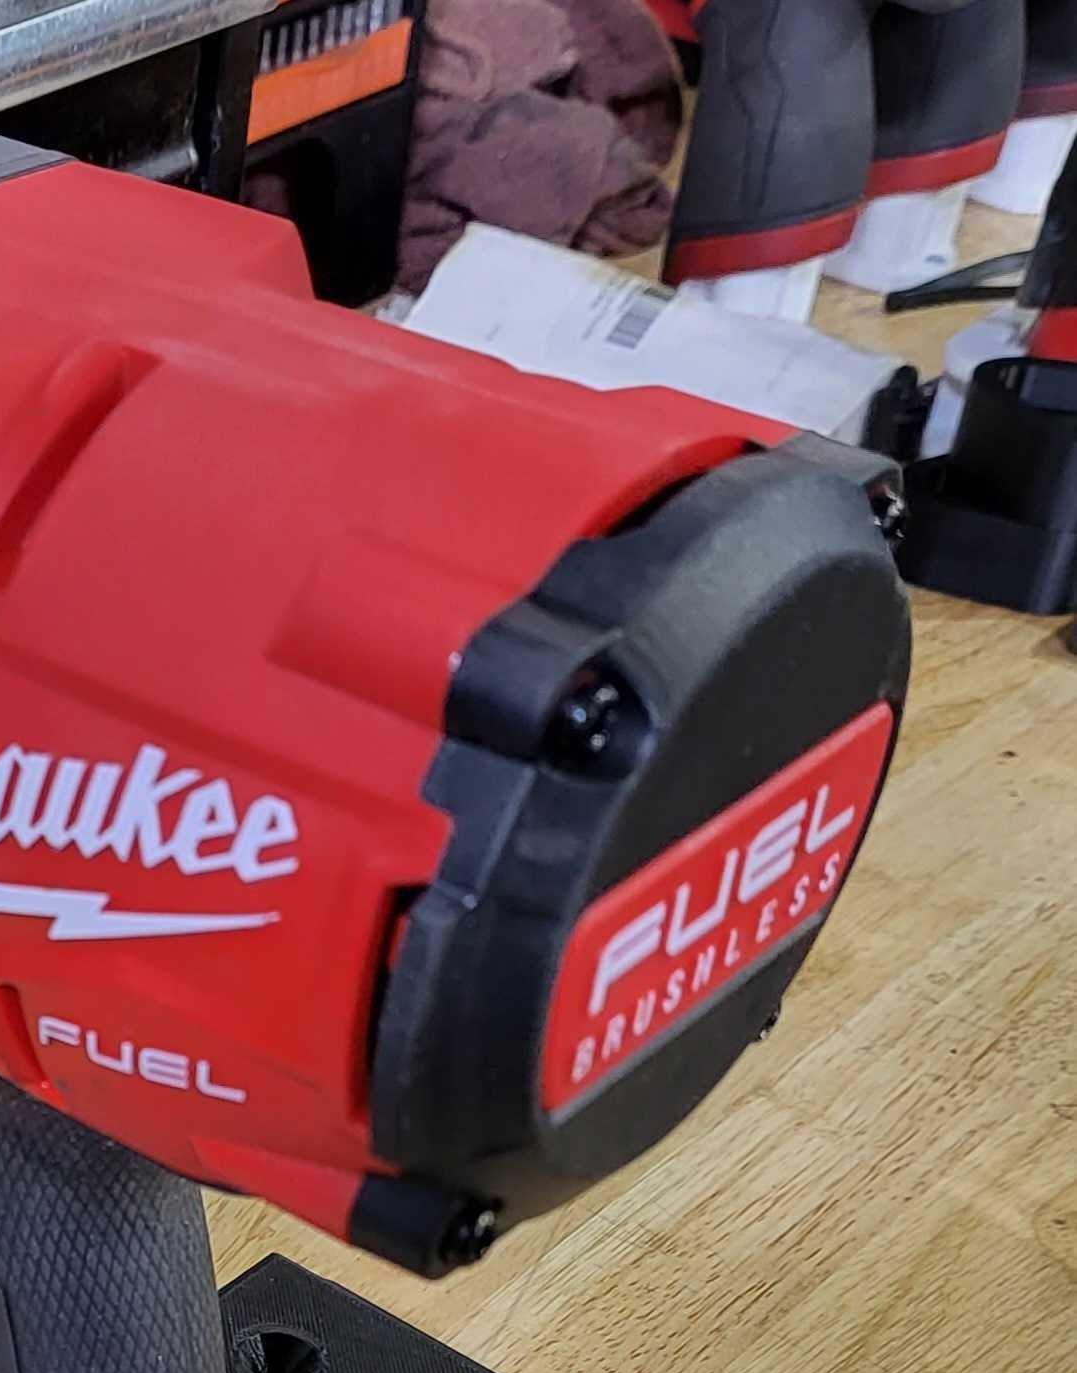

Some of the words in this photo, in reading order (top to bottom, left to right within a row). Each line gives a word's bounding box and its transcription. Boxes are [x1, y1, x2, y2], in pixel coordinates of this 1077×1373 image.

[571, 852, 841, 1082] BRUSHLESS
[587, 784, 856, 1017] FUEL
[38, 1016, 246, 1103] FUEL
